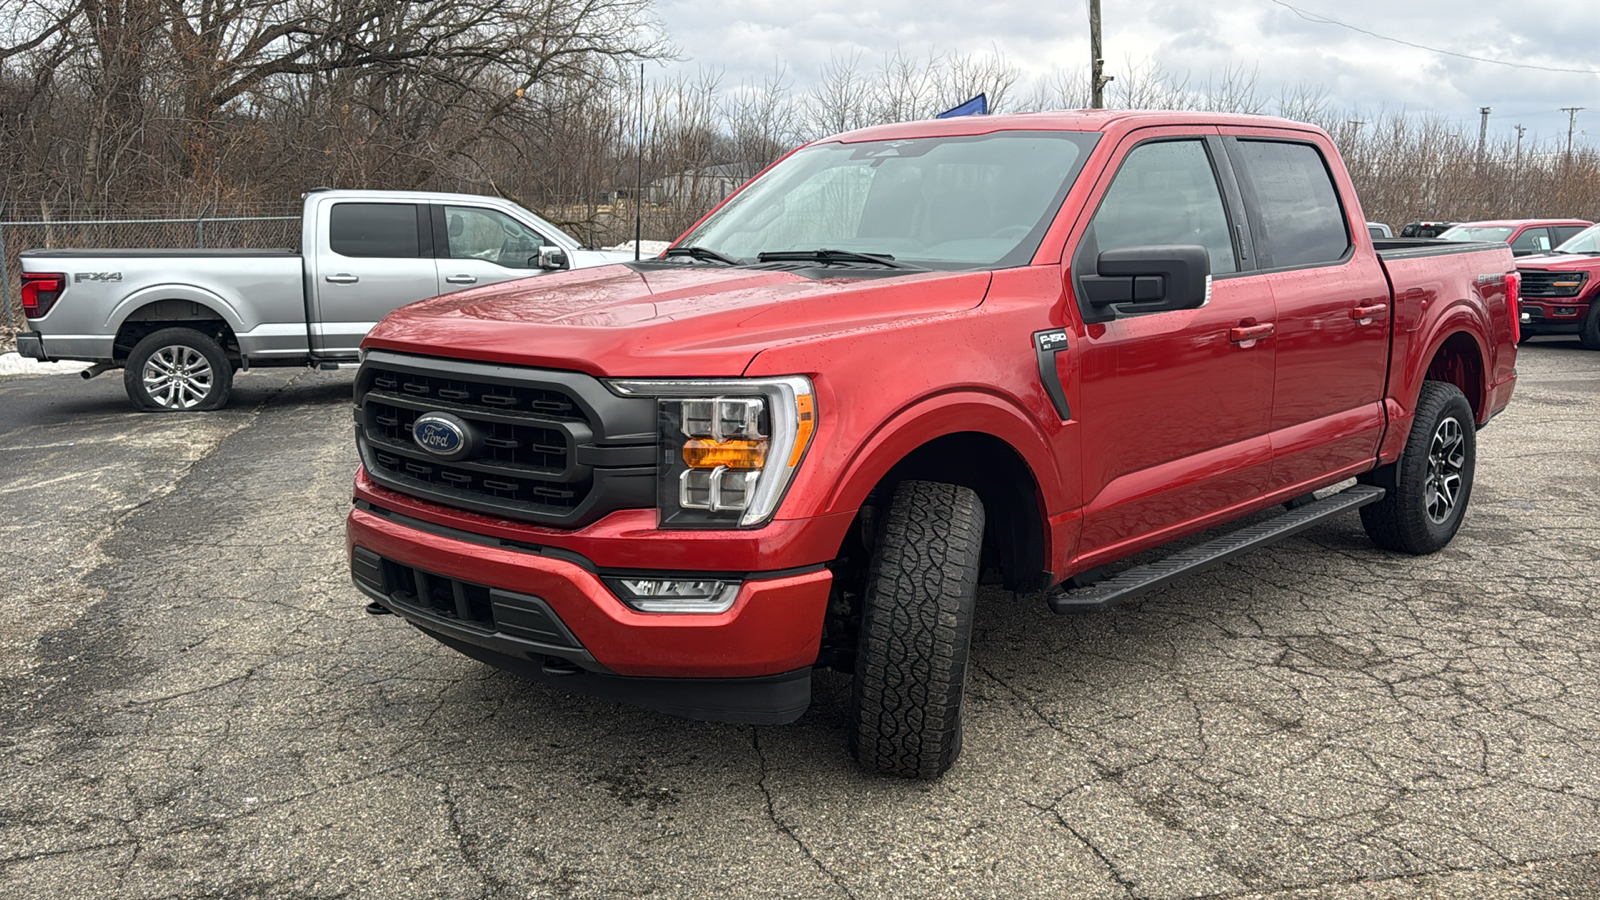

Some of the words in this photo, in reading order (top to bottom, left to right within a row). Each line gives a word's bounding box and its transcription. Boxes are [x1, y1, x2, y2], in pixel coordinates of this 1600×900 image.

[74, 272, 122, 283] FX4
[1040, 333, 1067, 344] F-150
[422, 424, 450, 447] Ford
